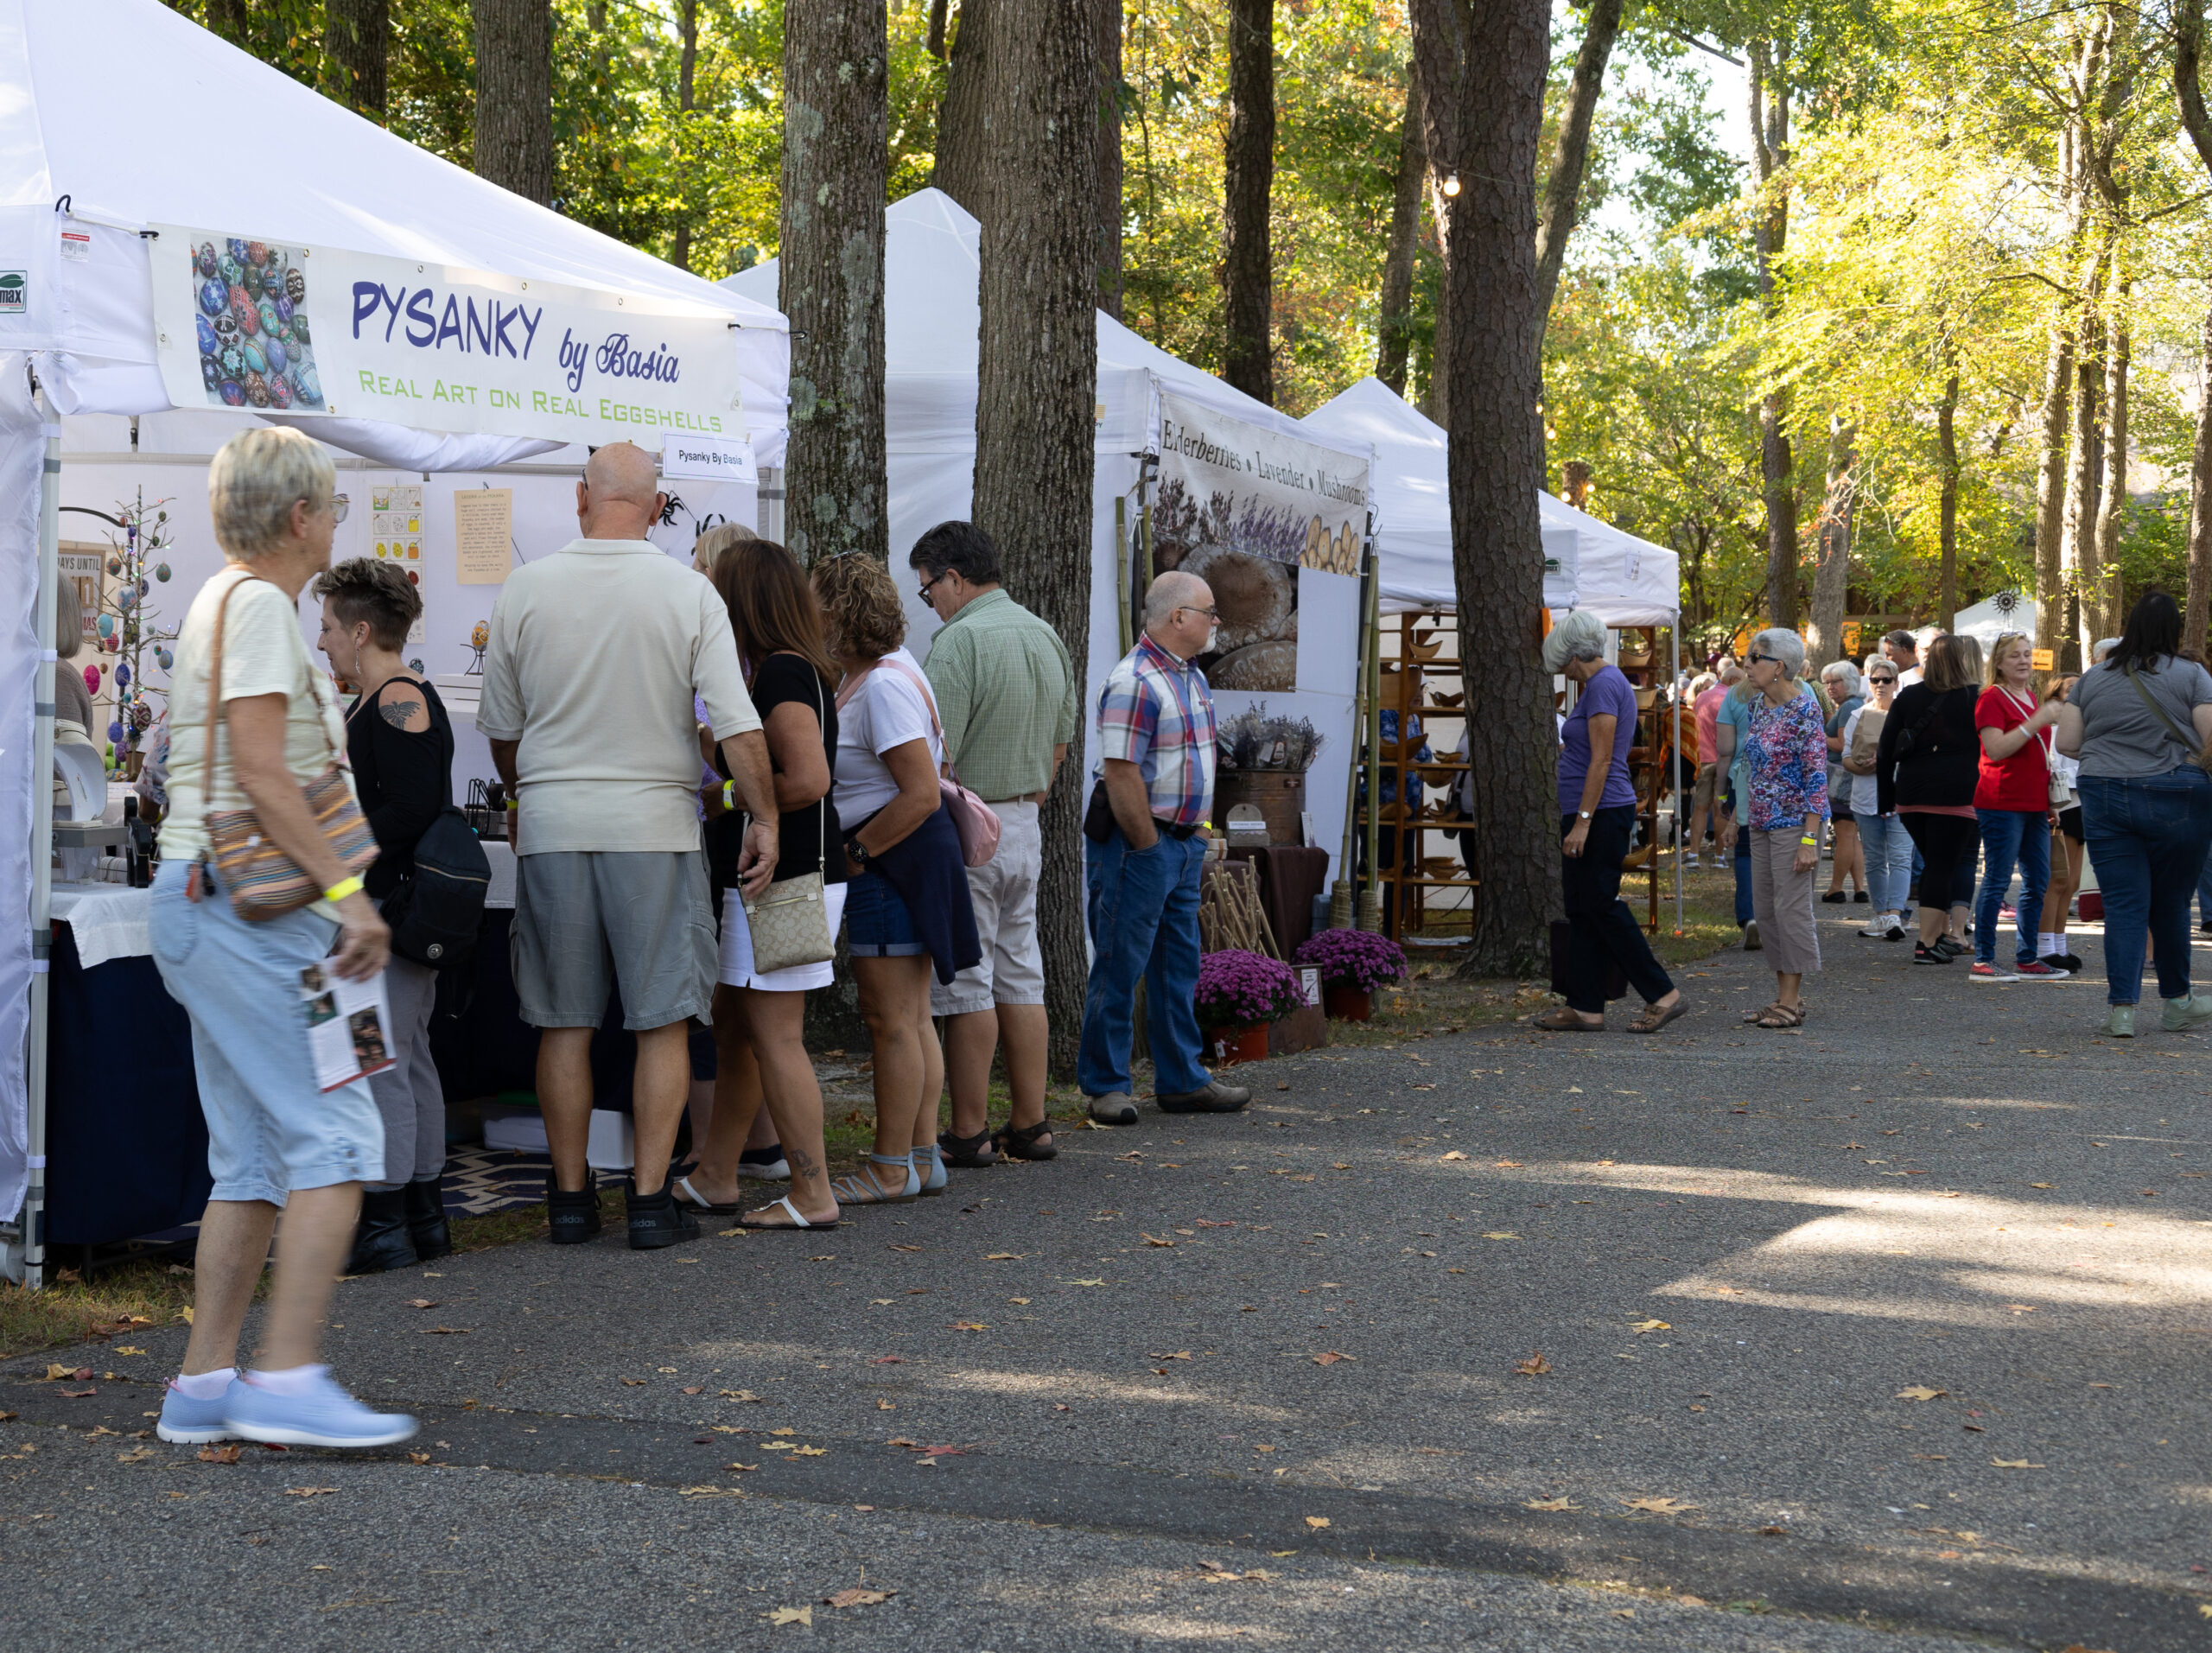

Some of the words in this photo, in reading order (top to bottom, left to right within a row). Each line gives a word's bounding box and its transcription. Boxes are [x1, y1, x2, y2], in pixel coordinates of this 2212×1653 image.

[353, 281, 543, 360] PYSANKY
[558, 327, 588, 392] by
[595, 333, 680, 383] Basia
[489, 389, 521, 410] ON
[678, 449, 710, 464] Pysanky
[712, 453, 722, 465] By
[723, 454, 742, 465] Basia
[1162, 419, 1242, 472] Elderberries
[1255, 450, 1305, 489] Lavender
[1317, 469, 1365, 506] Mushrooms
[58, 556, 75, 570] AYS
[77, 557, 100, 570] UNTIL
[555, 1215, 585, 1224] adidas
